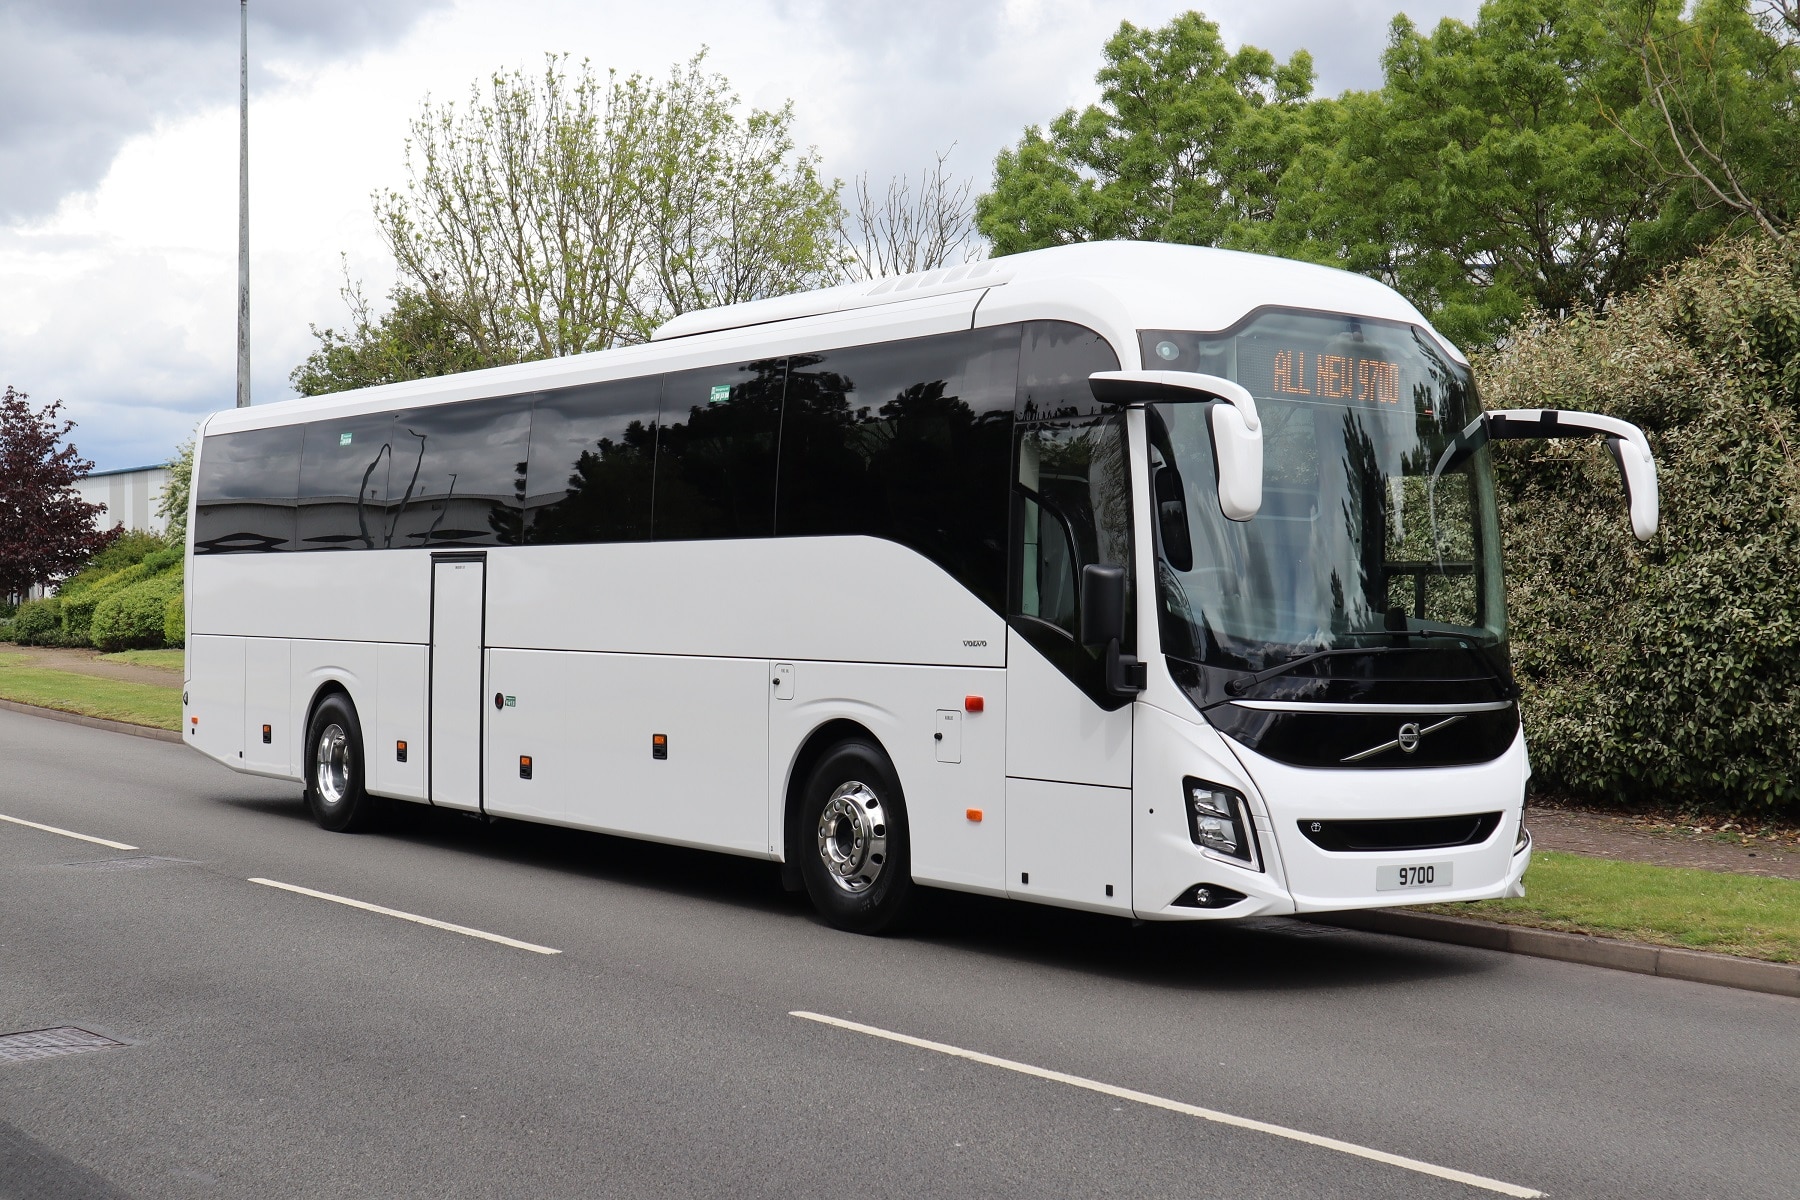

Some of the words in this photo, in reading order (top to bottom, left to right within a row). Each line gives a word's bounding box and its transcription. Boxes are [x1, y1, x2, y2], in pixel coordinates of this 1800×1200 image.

[1274, 350, 1311, 395] ALL
[1316, 354, 1353, 398] NEW
[1358, 359, 1399, 404] 9700
[1399, 865, 1434, 886] 9700
